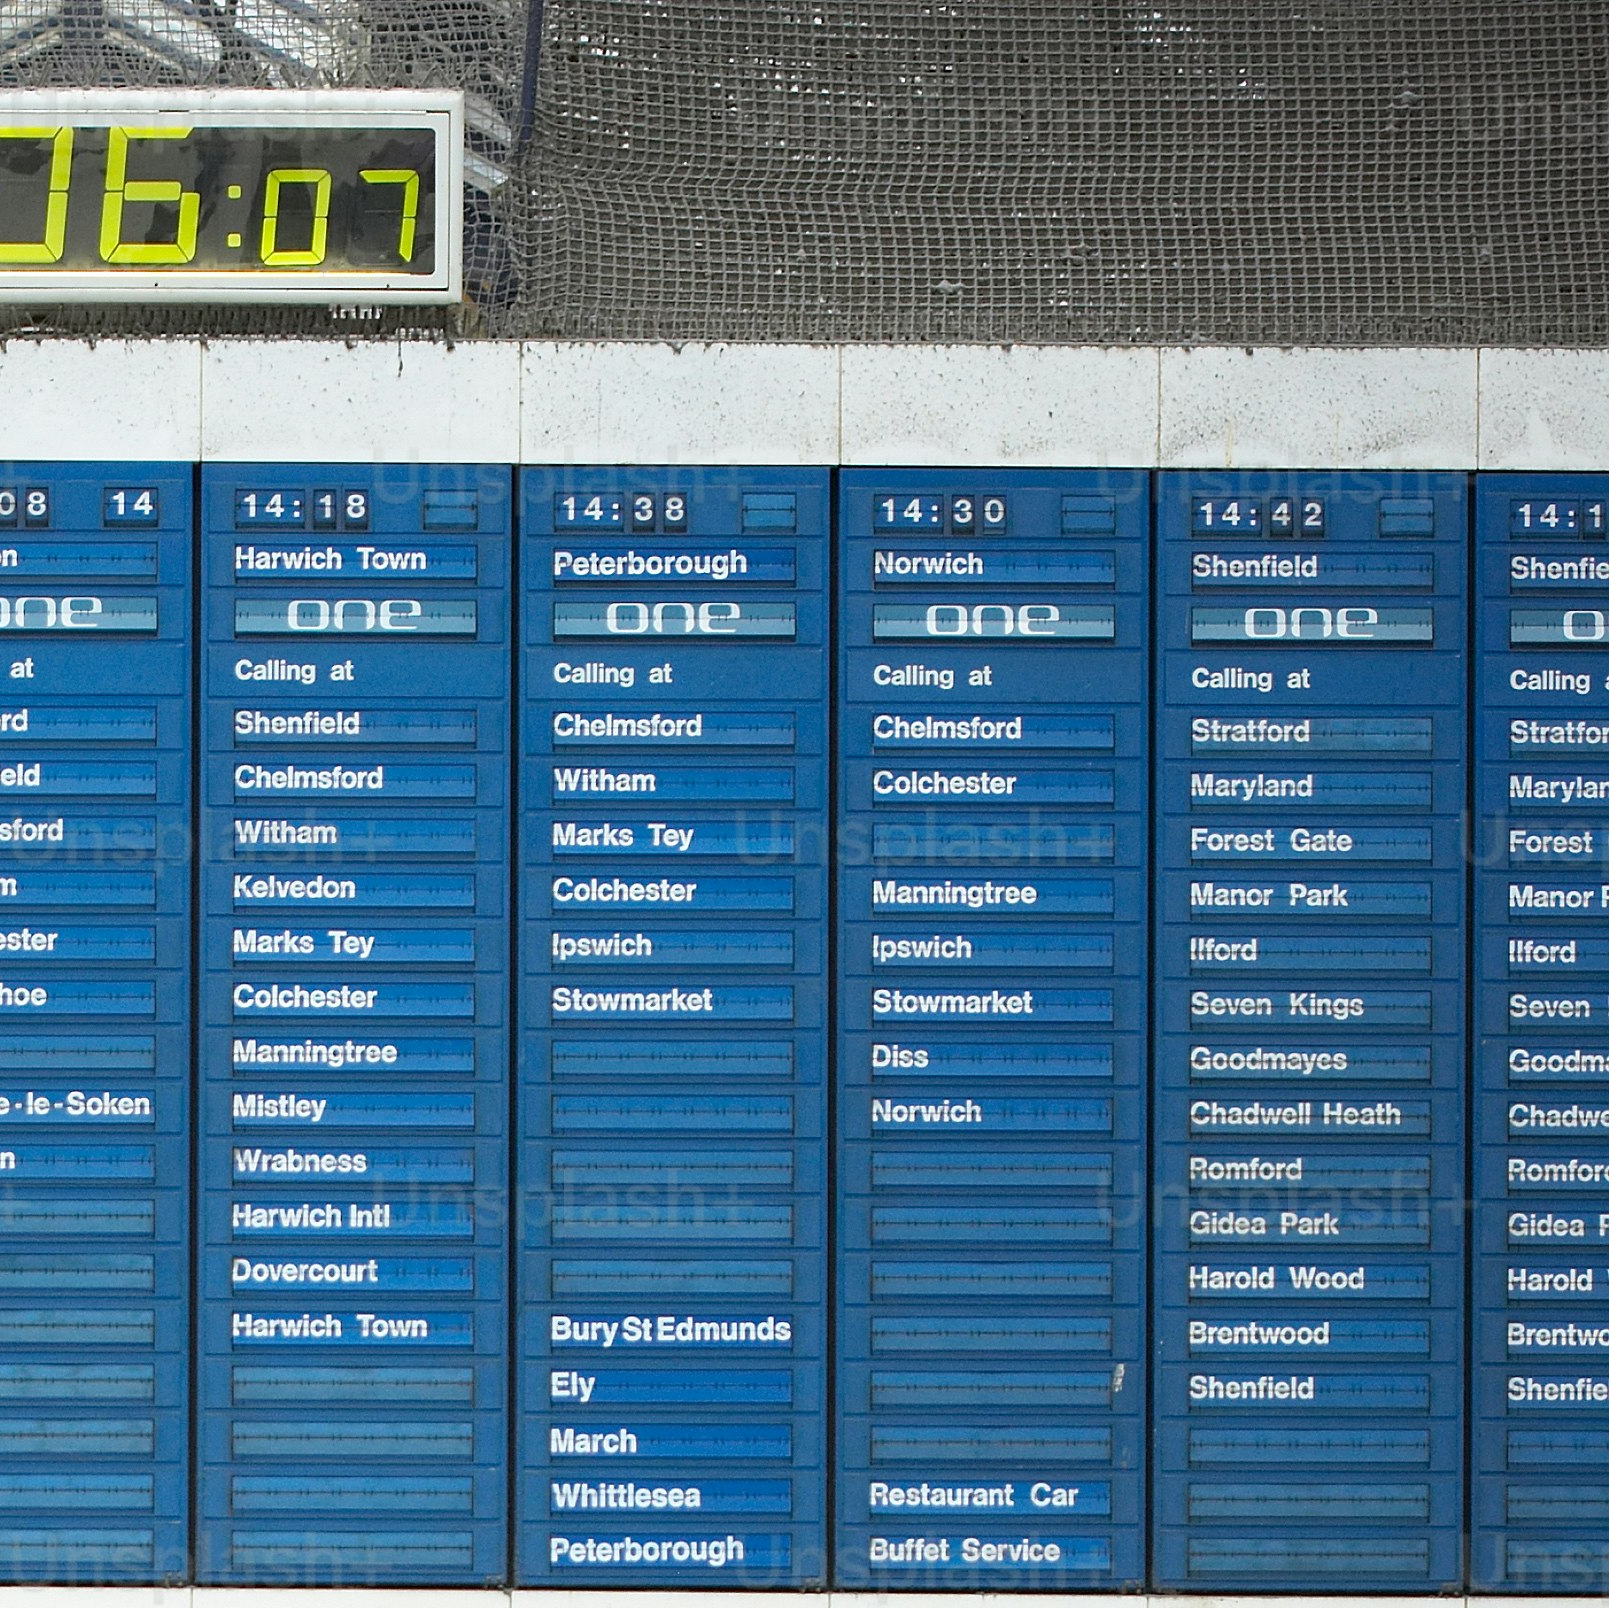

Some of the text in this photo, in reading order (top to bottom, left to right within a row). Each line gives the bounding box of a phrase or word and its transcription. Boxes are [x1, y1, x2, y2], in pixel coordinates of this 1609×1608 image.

[112, 491, 153, 515] 14
[563, 496, 684, 521] 14:38
[1200, 502, 1321, 526] 14:42
[554, 549, 747, 580] Peterborough
[1193, 554, 1317, 578] Shenfield
[1192, 718, 1310, 742] Stratford
[1191, 773, 1313, 801] Maryland
[552, 823, 694, 851] Marks Tey
[1191, 828, 1353, 852] Forest Gate
[552, 933, 652, 961] Ipswich
[1190, 938, 1257, 961] Ilford
[552, 987, 713, 1012] Stowmarket
[233, 1094, 327, 1122] Mistley
[1190, 1101, 1401, 1125] Chadwell Heath
[1190, 1210, 1339, 1235] Gidea Park
[551, 1316, 792, 1347] Bury St Edmunds
[1189, 1321, 1329, 1345] Brentwood
[551, 1371, 596, 1403] Ely
[550, 1428, 637, 1453] March
[552, 1483, 701, 1508] Whittlesea
[870, 1482, 1079, 1507] Restaurant Car
